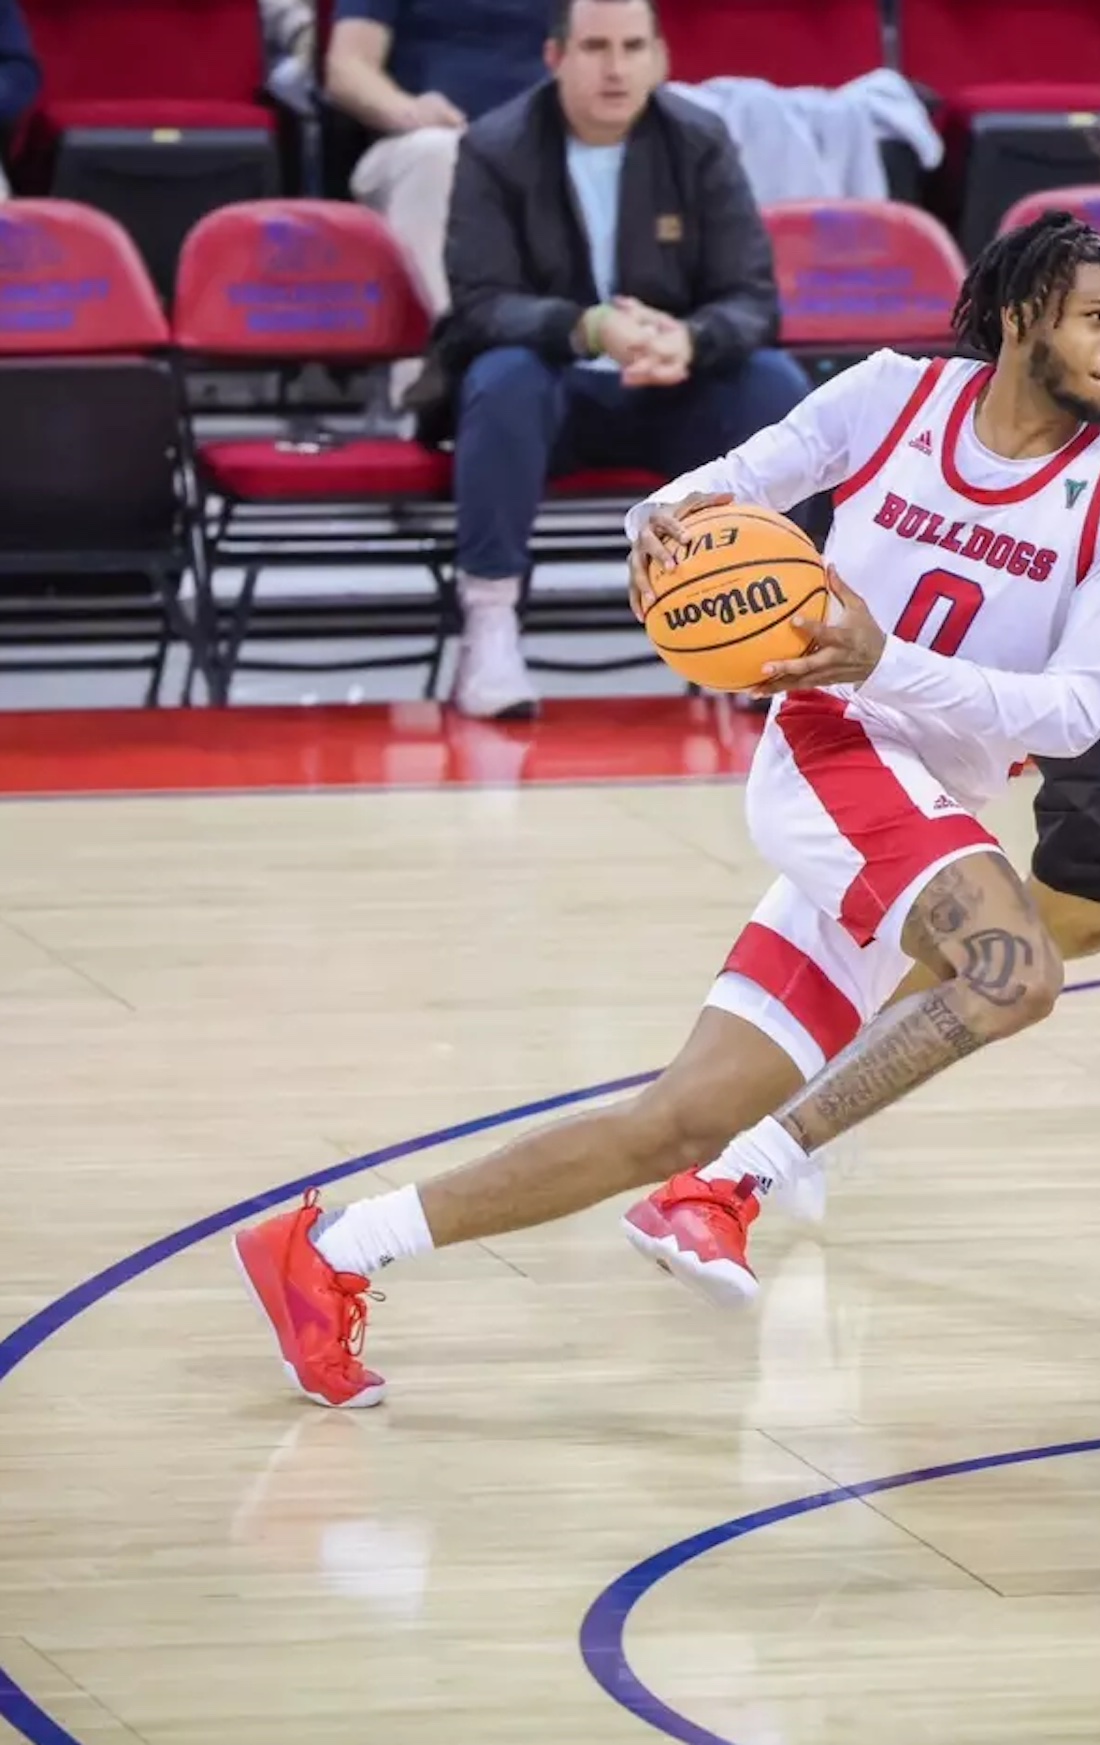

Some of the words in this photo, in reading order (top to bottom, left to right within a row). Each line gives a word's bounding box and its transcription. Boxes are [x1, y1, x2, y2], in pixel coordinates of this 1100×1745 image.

[873, 491, 1058, 582] BULLDOGS
[664, 575, 788, 630] Wilson
[892, 566, 986, 659] 0
